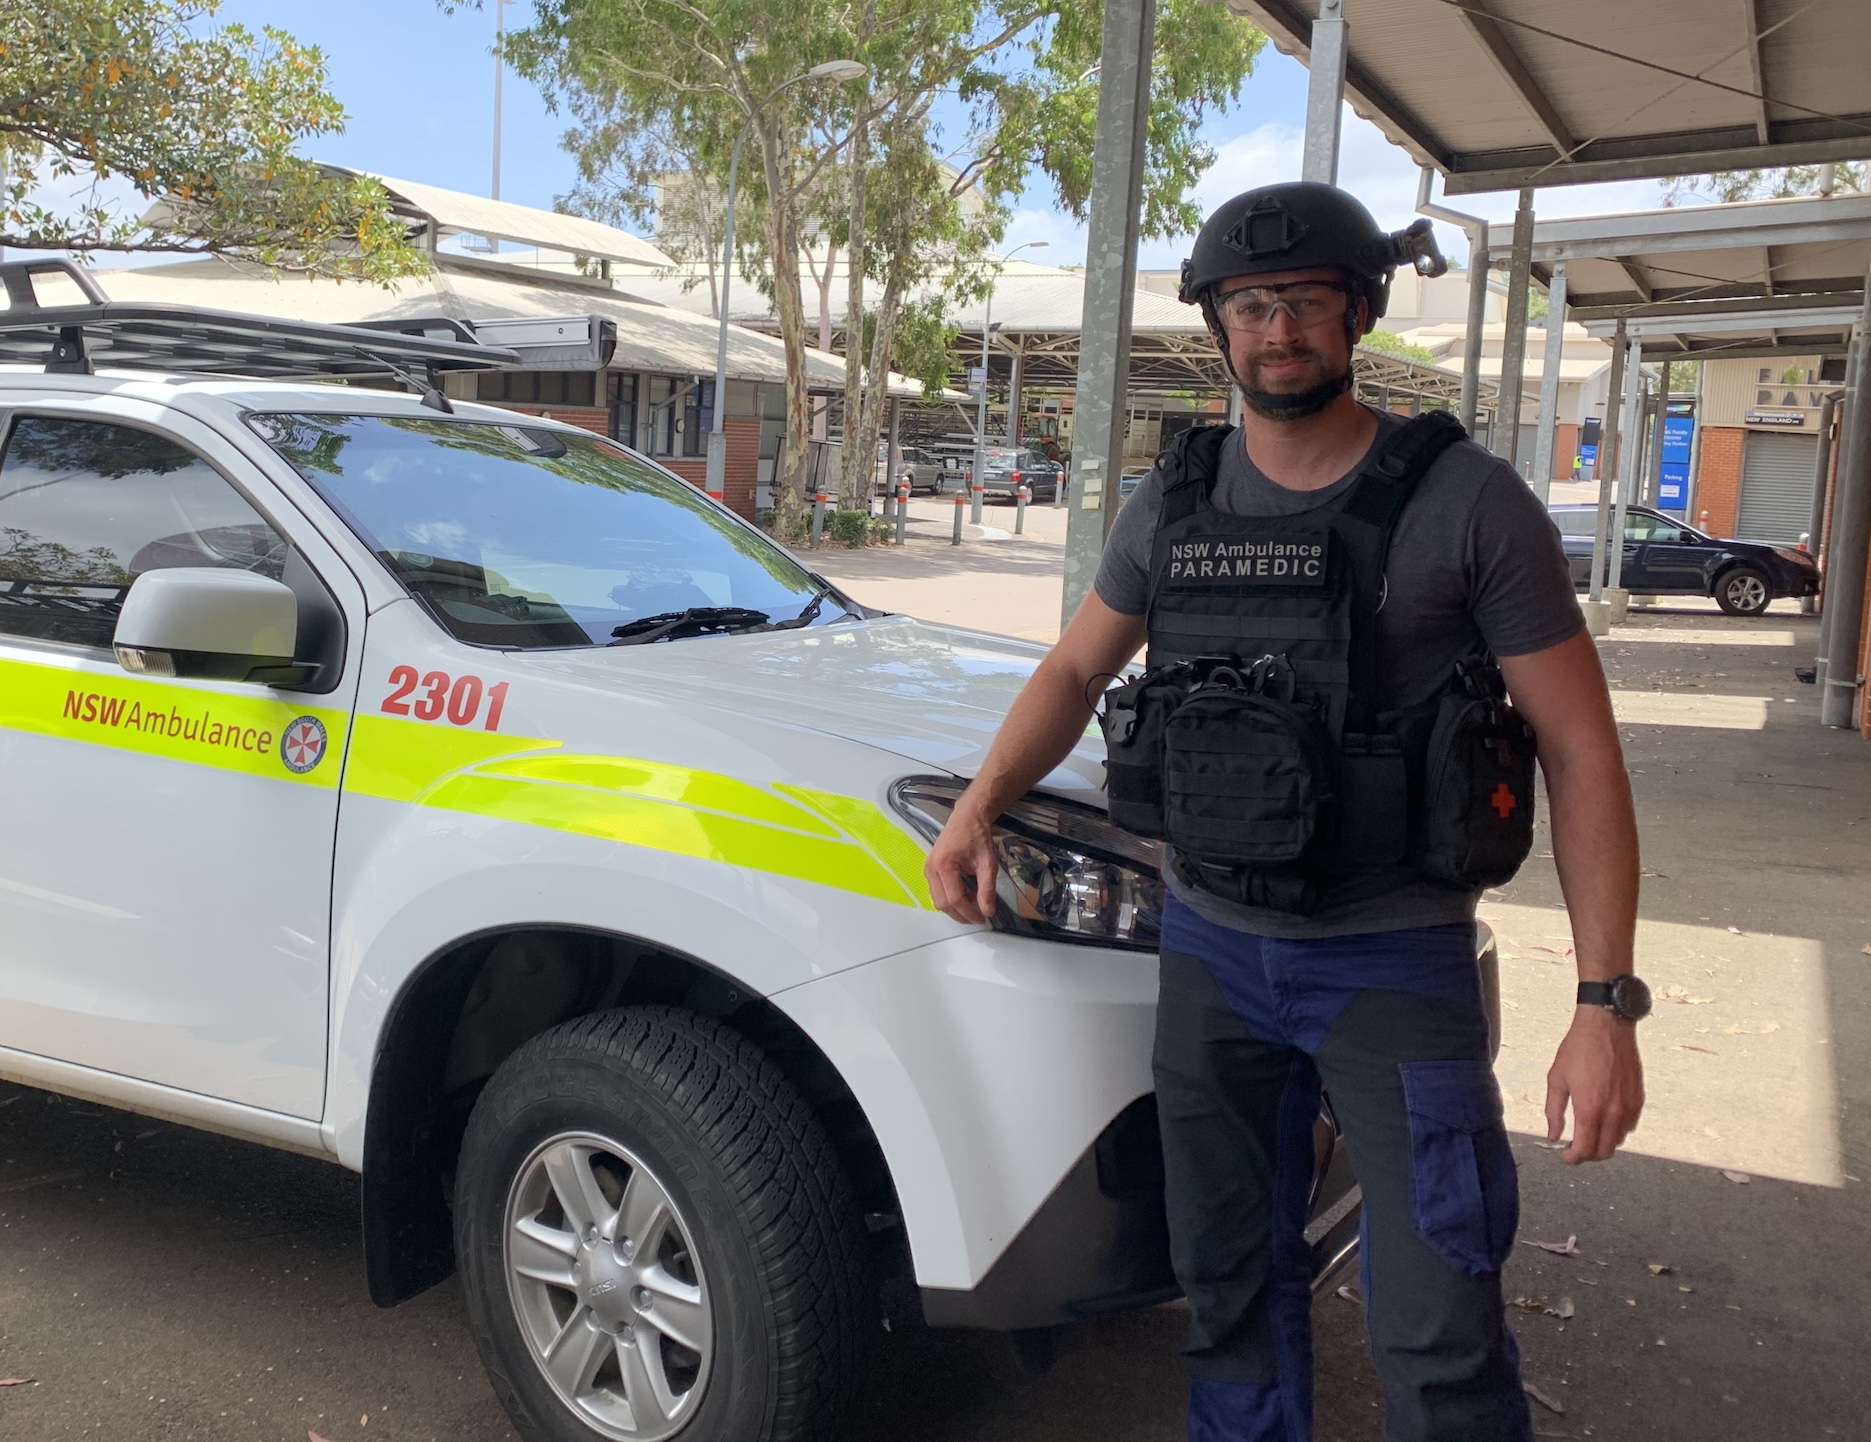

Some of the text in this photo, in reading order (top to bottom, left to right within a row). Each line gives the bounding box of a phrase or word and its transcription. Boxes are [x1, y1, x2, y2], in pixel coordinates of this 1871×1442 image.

[1170, 559, 1320, 578] PARAMEDIC
[1172, 541, 1322, 559] NSW Ambulance
[381, 665, 509, 731] 2301
[63, 690, 273, 754] NSW Ambulance
